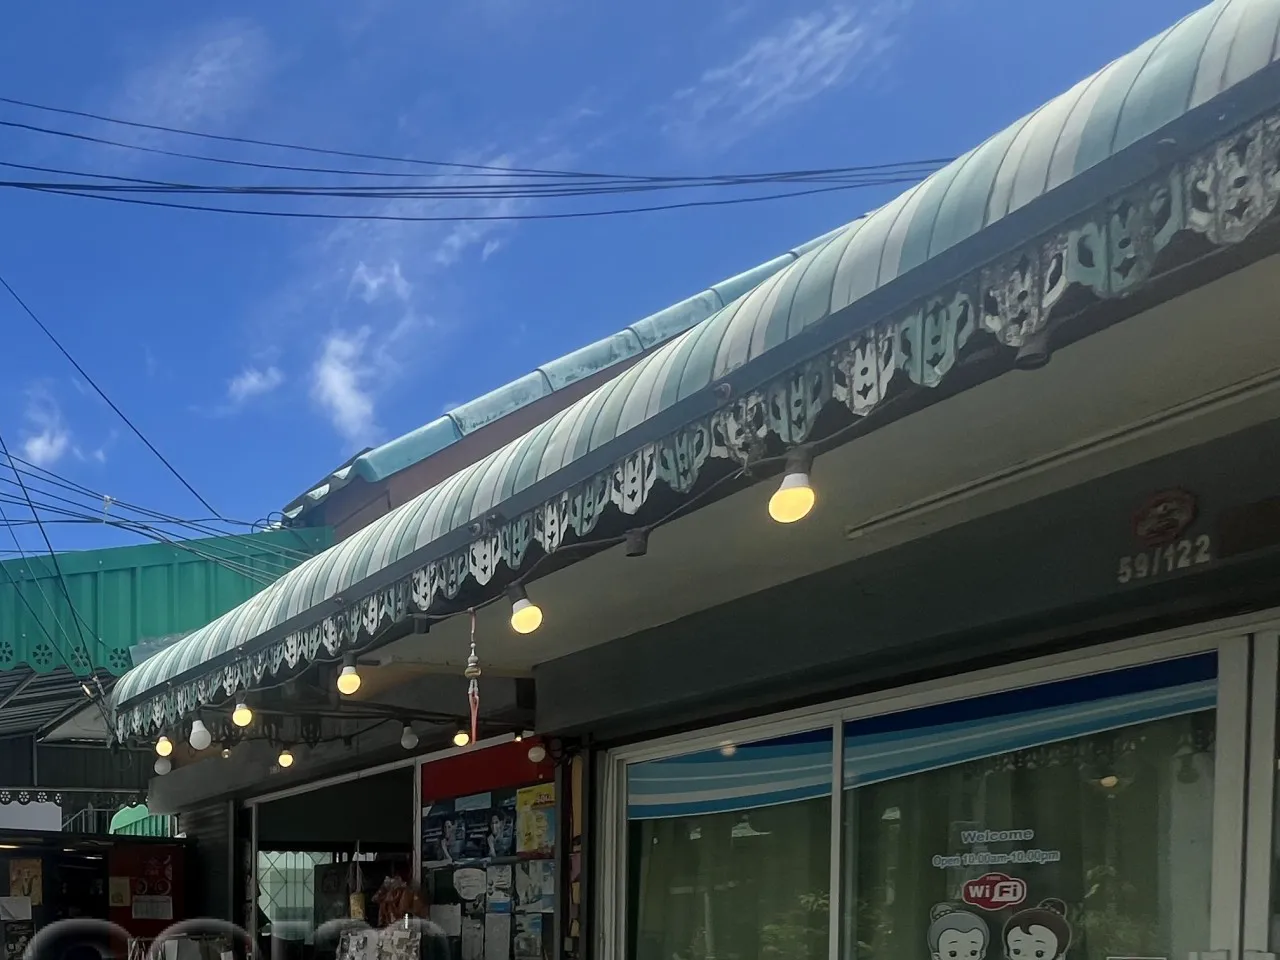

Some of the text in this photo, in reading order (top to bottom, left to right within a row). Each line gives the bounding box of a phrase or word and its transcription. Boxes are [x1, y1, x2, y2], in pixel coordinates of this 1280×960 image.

[1117, 534, 1211, 584] 59/122
[961, 829, 1035, 844] Welcome
[932, 855, 961, 868] Open
